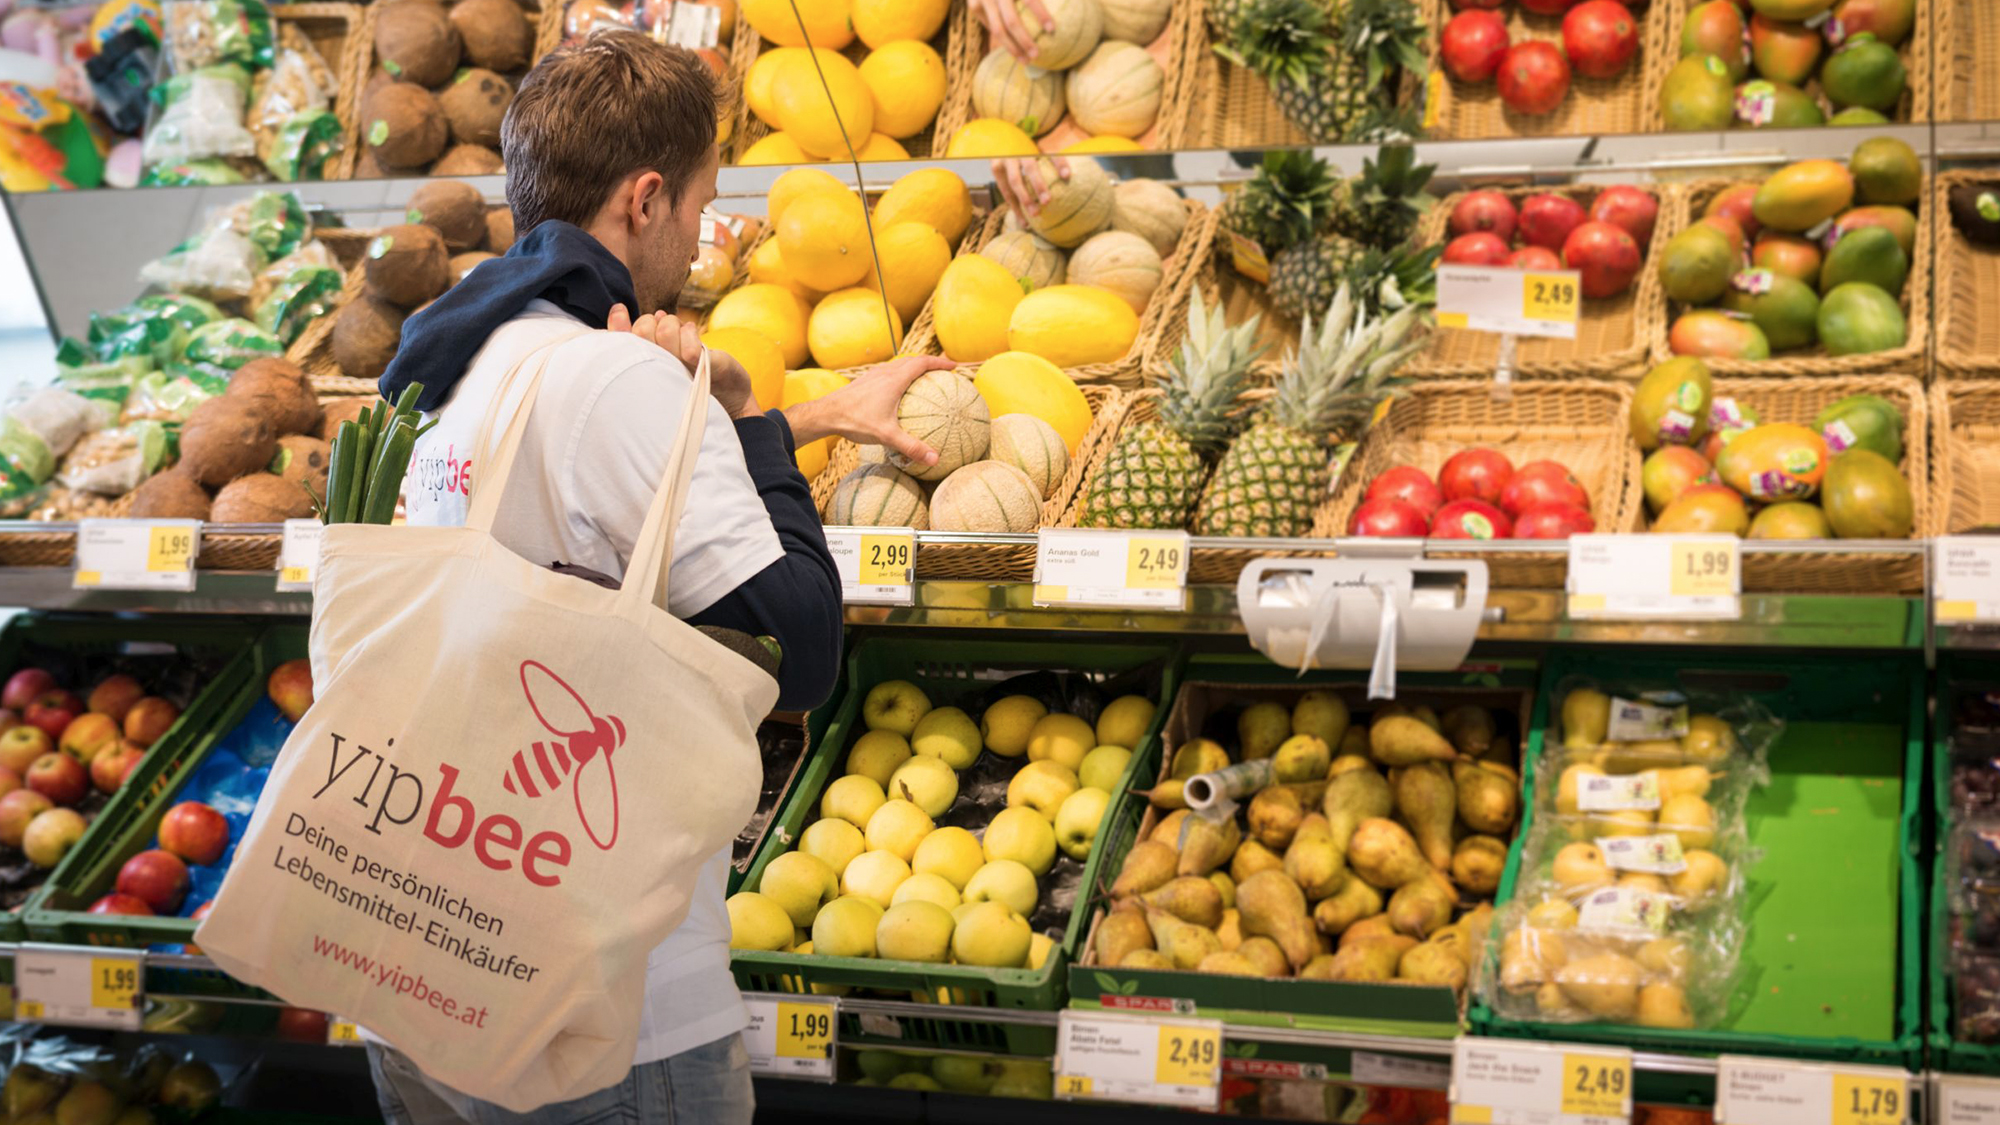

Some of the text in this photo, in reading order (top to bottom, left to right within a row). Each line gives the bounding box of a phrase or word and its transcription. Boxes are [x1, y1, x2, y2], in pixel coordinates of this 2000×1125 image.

[1534, 282, 1575, 306] 2,49
[159, 535, 190, 556] 1,99
[871, 544, 908, 570] 2,99
[1047, 547, 1100, 558] Ananas Gold
[1138, 547, 1179, 573] 2,49
[1686, 551, 1730, 577] 1,99
[312, 733, 572, 887] yipbee
[285, 812, 504, 936] Deine persönlichen
[274, 845, 540, 984] Lebensmittel-Einkäufer
[102, 967, 136, 993] 1,99
[312, 934, 490, 1029] www.yipbee.at
[1113, 996, 1172, 1009] SPAR
[790, 1012, 829, 1041] 1,99
[1170, 1037, 1215, 1067] 2,49
[1230, 1060, 1300, 1074] SPAR
[1576, 1064, 1625, 1097] 2,49
[1849, 1086, 1898, 1117] 1,79
